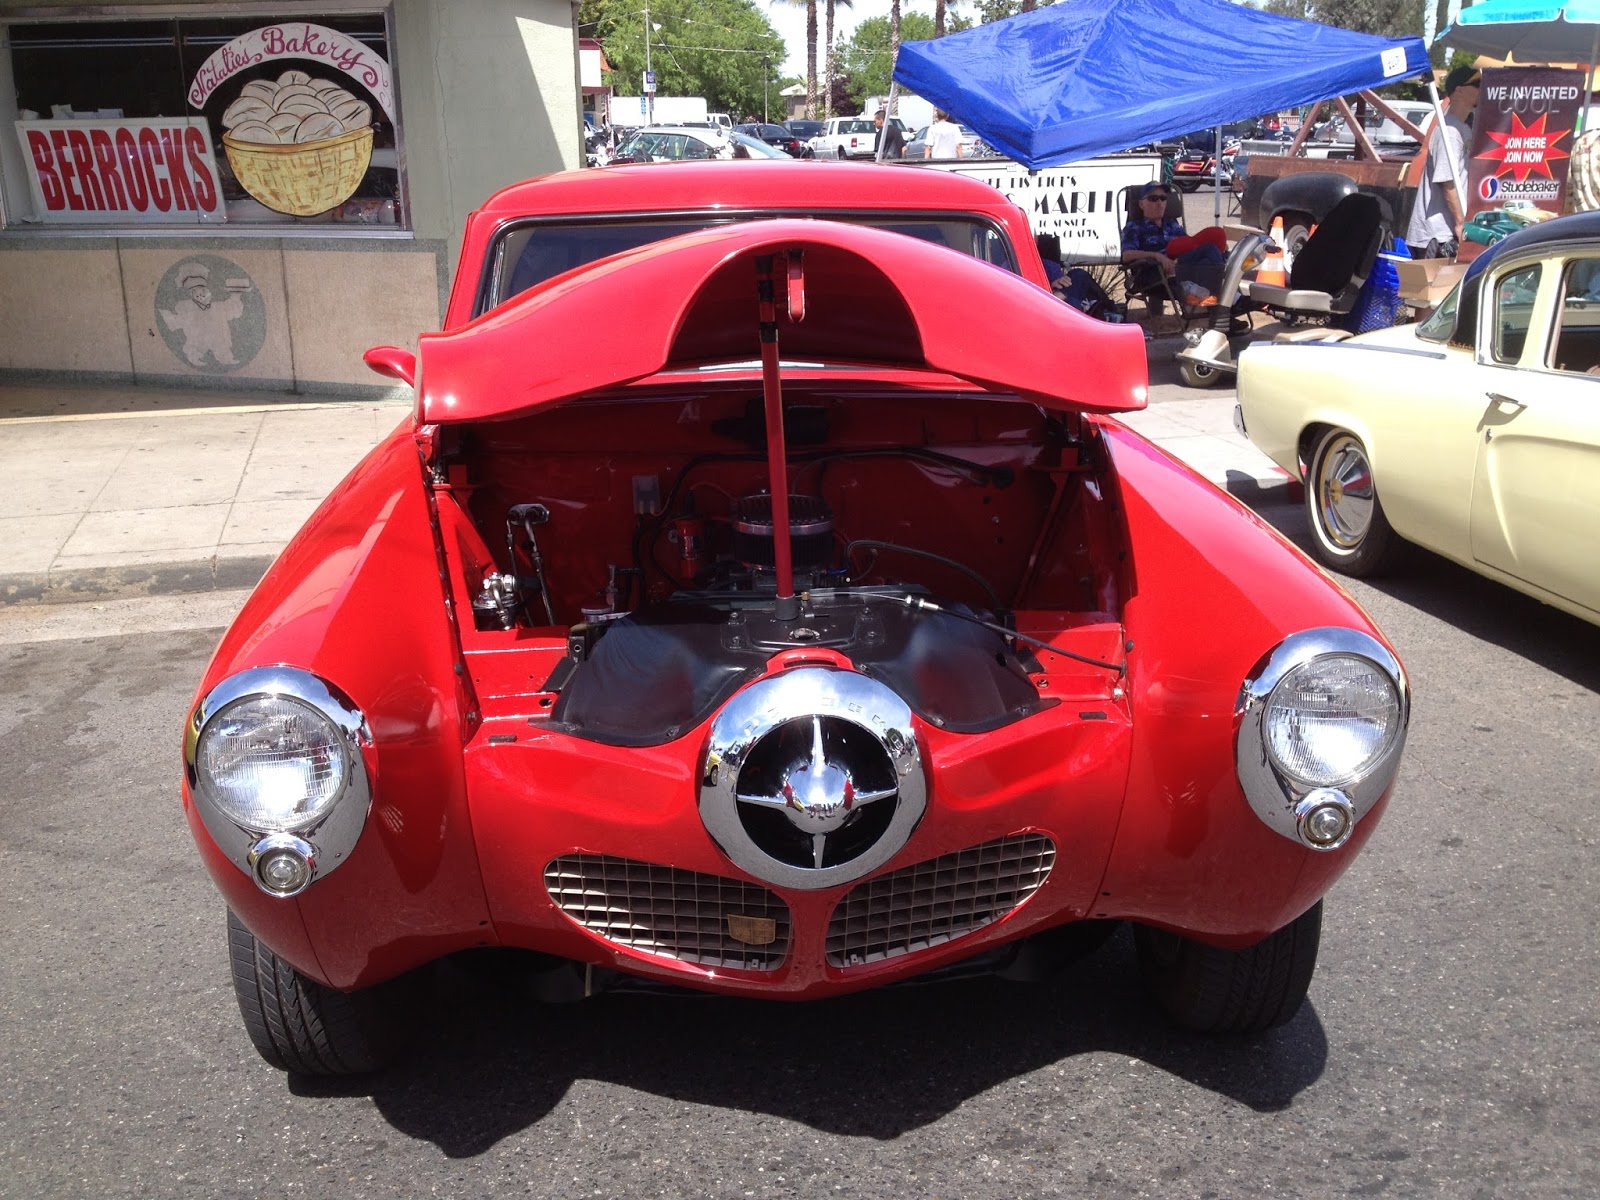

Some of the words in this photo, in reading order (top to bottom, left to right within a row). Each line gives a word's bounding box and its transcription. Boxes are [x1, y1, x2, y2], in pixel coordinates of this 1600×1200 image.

[261, 25, 379, 88] Bakery
[1487, 86, 1507, 100] WE
[1509, 86, 1578, 100] INVENTED
[1498, 95, 1559, 113] COOL
[1505, 137, 1522, 149] JOIN
[1523, 137, 1546, 149] HERE
[1504, 151, 1522, 163] JOIN
[1523, 151, 1544, 163] NOW
[26, 127, 217, 212] BERROCKS
[1501, 180, 1558, 193] Studebaker
